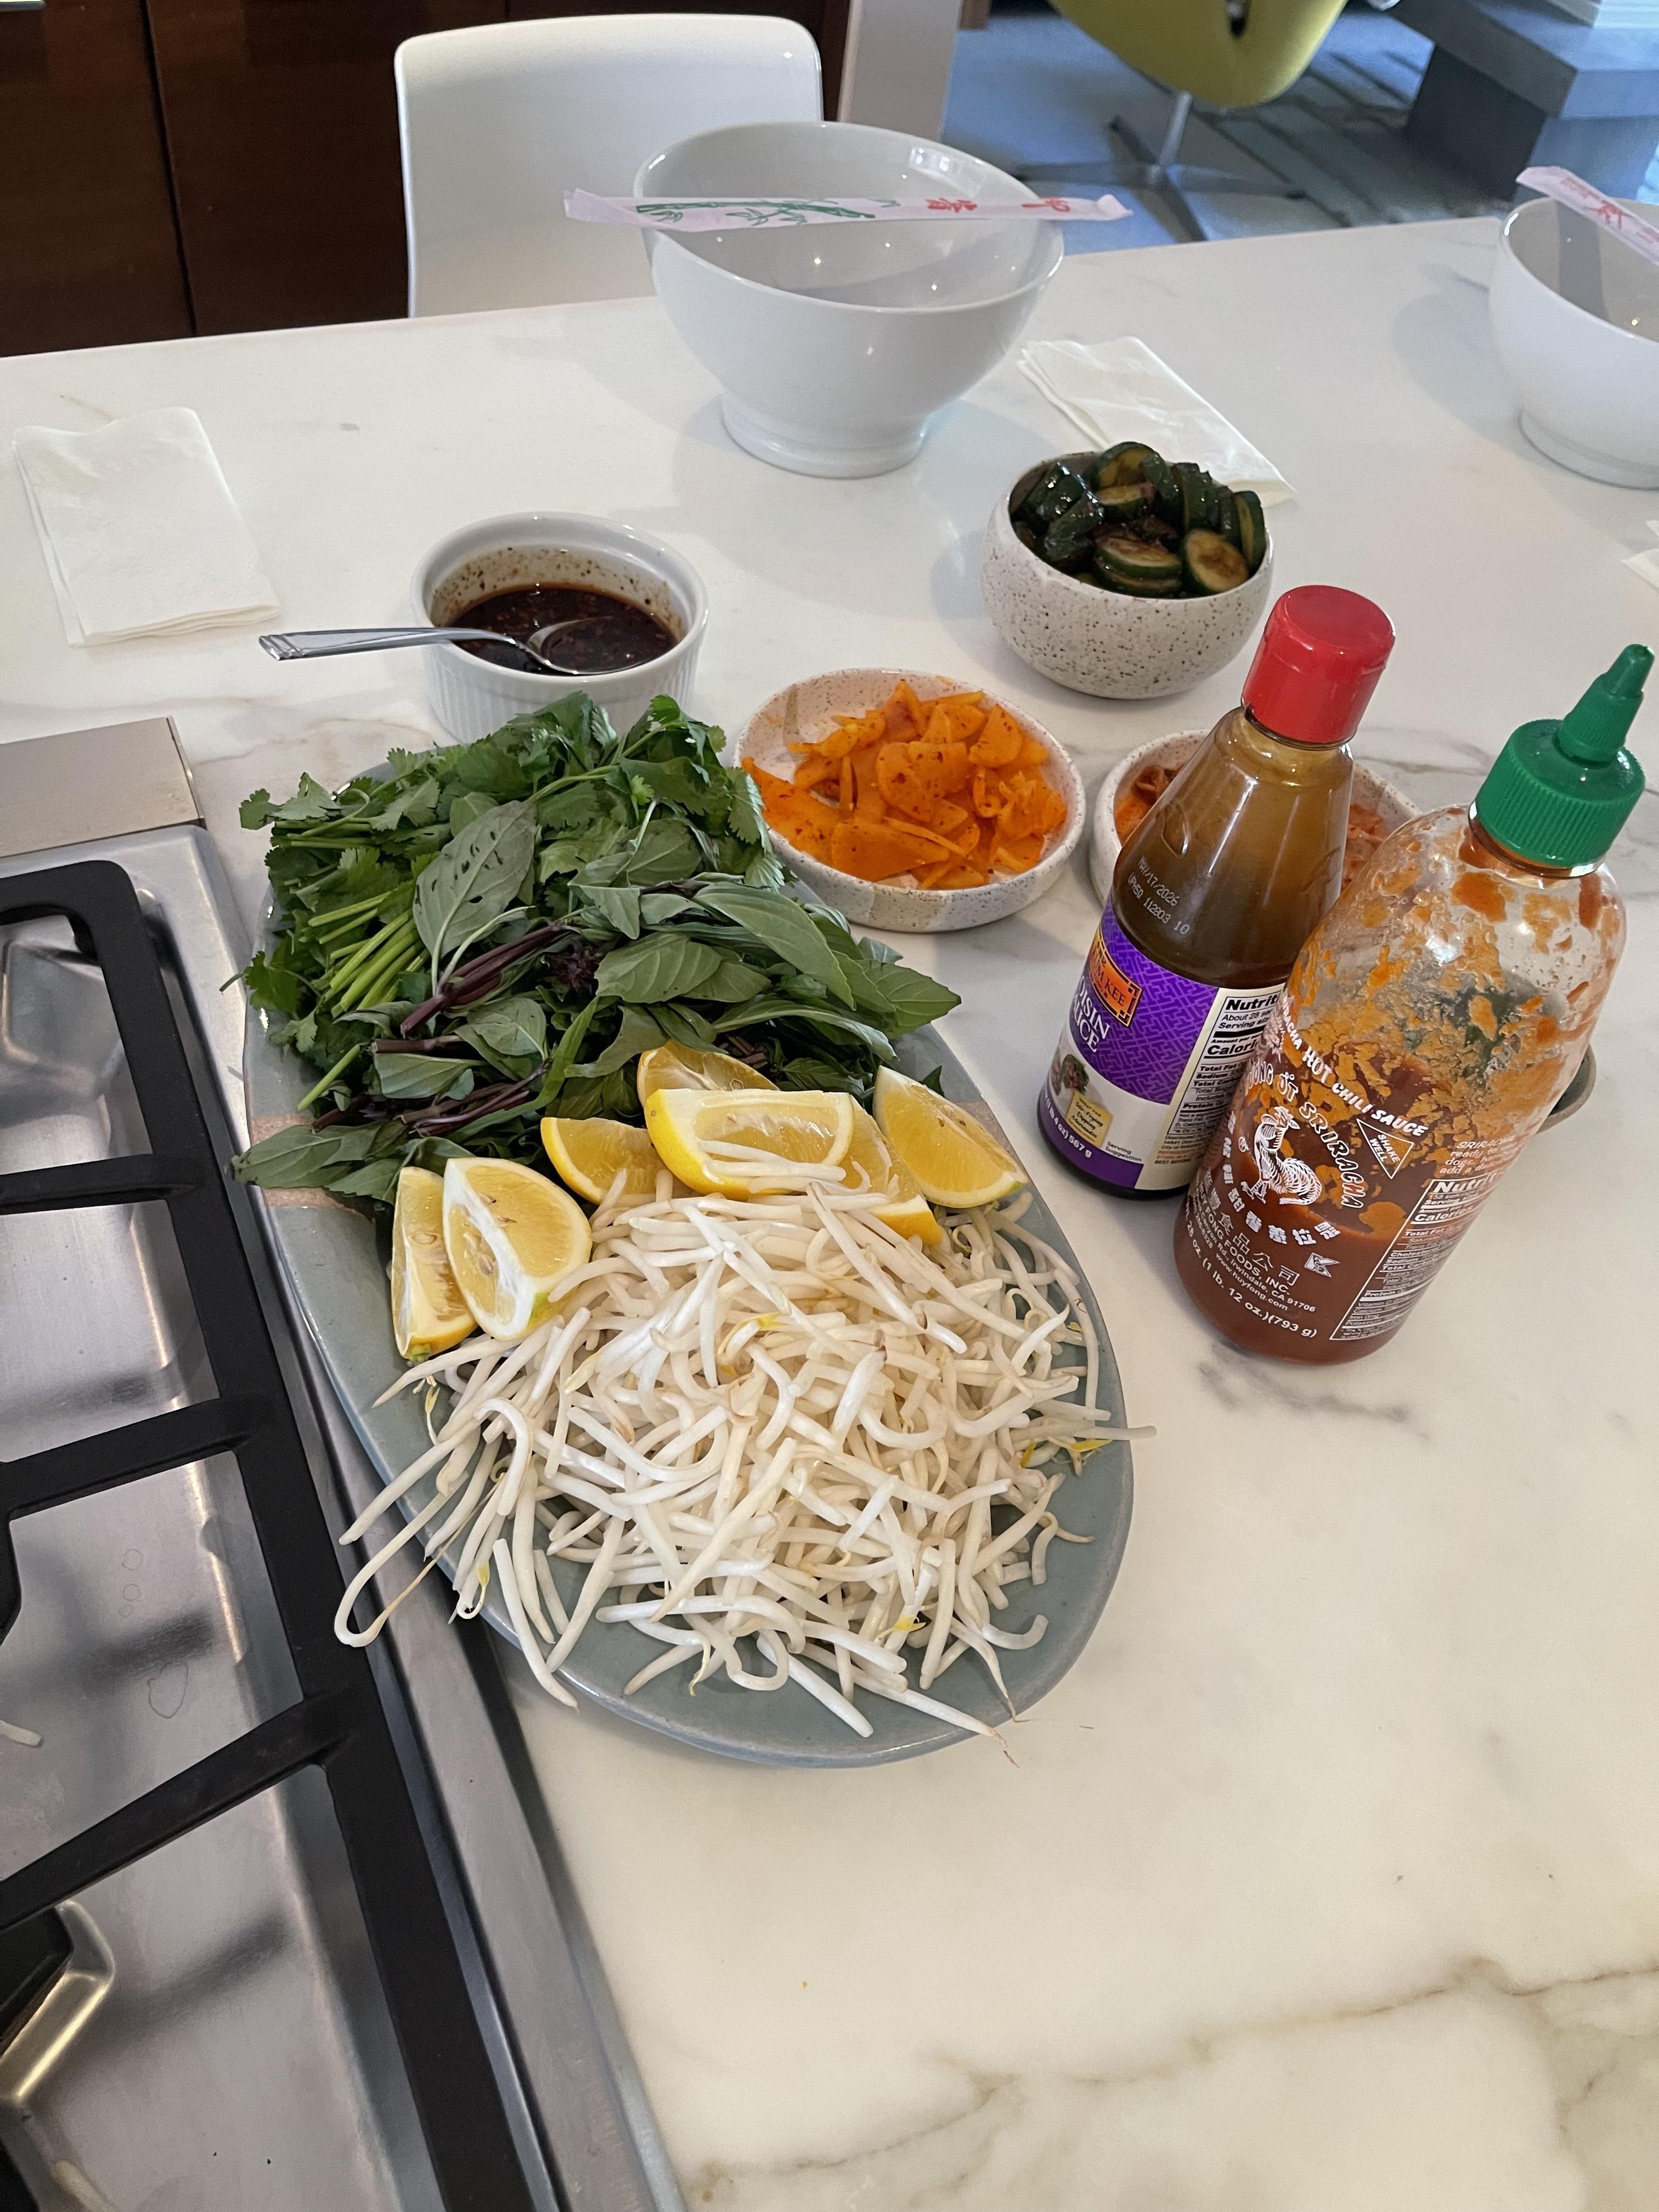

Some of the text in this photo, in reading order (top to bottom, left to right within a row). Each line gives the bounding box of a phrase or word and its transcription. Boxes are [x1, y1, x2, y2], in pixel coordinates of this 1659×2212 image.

[1173, 921, 1190, 934] 10
[1104, 978, 1126, 1006] KEE
[1226, 994, 1278, 1010] Nutrit
[1079, 976, 1110, 1039] OISIN
[1073, 994, 1099, 1053] AUCE
[1218, 1021, 1255, 1029] Serving
[1207, 1040, 1257, 1056] Calori
[1302, 1045, 1333, 1085] HOT
[1332, 1082, 1373, 1113] CHILI
[1370, 1110, 1429, 1136] SAUCE
[1069, 1135, 1085, 1151] 567
[1107, 1141, 1132, 1154] Serving
[1369, 1138, 1388, 1162] WELL
[1378, 1134, 1401, 1163] SHAKE
[1105, 1146, 1142, 1163] Suggestion
[1299, 1102, 1367, 1209] SRIRACHA
[1450, 1150, 1484, 1159] ready
[1439, 1166, 1463, 1174] add
[1414, 1206, 1473, 1222] Calories
[1205, 1206, 1224, 1240] FONG
[1224, 1239, 1262, 1280] FOODS,
[1266, 1276, 1290, 1295] INC.
[1212, 1271, 1224, 1288] lb.
[1229, 1288, 1243, 1302] 12
[1216, 1252, 1289, 1311] www.huyfong.com
[1271, 1290, 1285, 1301] CA
[1286, 1298, 1317, 1312] 91706
